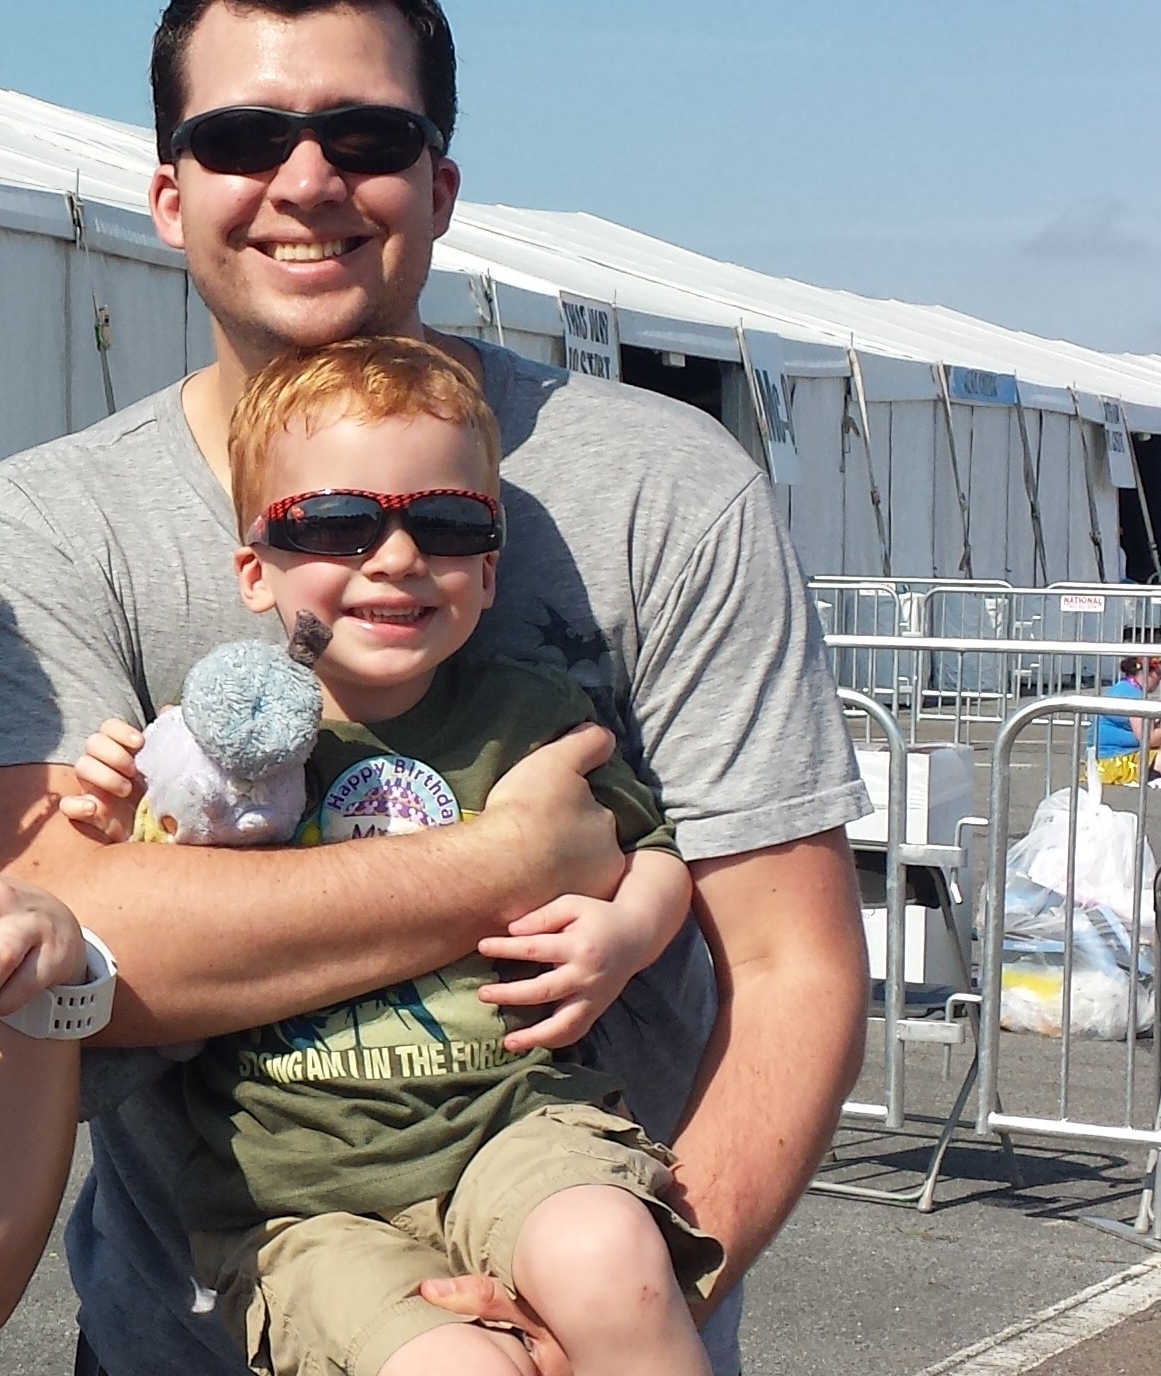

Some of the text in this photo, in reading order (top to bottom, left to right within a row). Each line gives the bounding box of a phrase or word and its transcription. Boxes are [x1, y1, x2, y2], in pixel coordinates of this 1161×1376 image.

[562, 301, 587, 339] THIS
[1064, 597, 1102, 606] NATIONAL
[327, 758, 455, 821] Happy Birthda
[306, 1048, 347, 1080] AM
[363, 1047, 392, 1080] IN
[396, 1043, 448, 1077] THE
[450, 1038, 523, 1073] FORC
